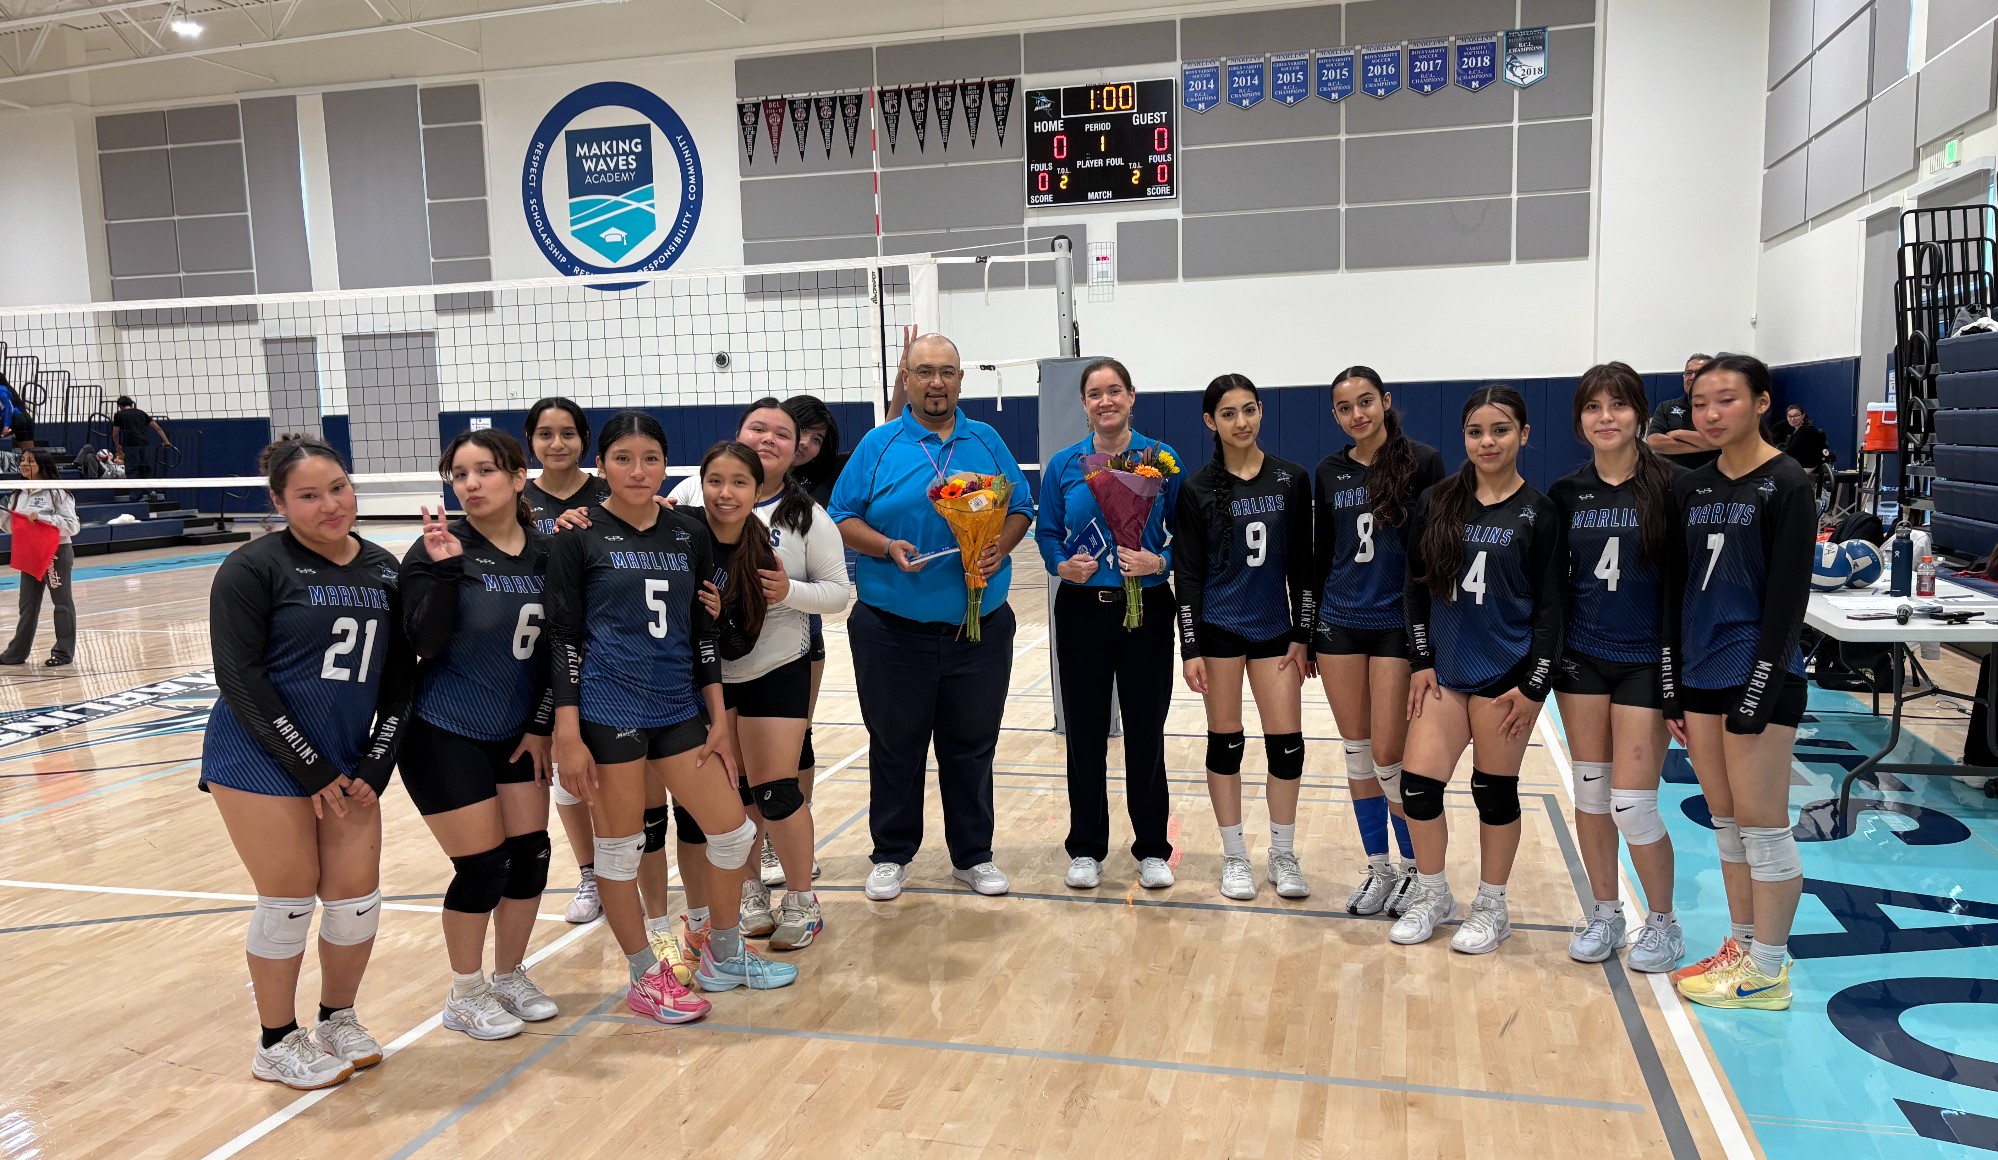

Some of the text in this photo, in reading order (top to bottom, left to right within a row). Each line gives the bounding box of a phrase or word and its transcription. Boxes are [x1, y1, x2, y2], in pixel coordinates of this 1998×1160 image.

[1367, 64, 1395, 77] 2016
[1414, 60, 1442, 73] 2017
[1461, 55, 1491, 69] 2018
[1521, 66, 1543, 77] 2018
[1232, 75, 1259, 88] 2014
[1276, 71, 1304, 84] 2015
[1321, 68, 1349, 80] 2015
[1188, 78, 1214, 91] 2014
[1090, 84, 1133, 111] 1:00
[1033, 120, 1065, 133] HOME
[1085, 122, 1111, 132] PERIOD
[1132, 111, 1168, 126] GUEST
[575, 138, 642, 158] MAKING
[1053, 135, 1067, 159] 0
[1100, 135, 1105, 152] 1
[1154, 127, 1168, 152] 0
[528, 141, 545, 188] RESPECT
[582, 154, 637, 173] WAVES
[675, 134, 697, 201] COMMUNITY
[1030, 162, 1053, 172] FOULS
[1076, 157, 1125, 169] PLAYER FOUL
[1148, 153, 1172, 163] FOULS
[584, 172, 636, 184] ACADEMY
[1038, 172, 1049, 192] 0
[1059, 175, 1069, 190] 2
[1131, 169, 1141, 185] 2
[1157, 164, 1168, 183] 0
[1030, 194, 1054, 204] SCORE
[1087, 191, 1112, 200] MATCH
[1146, 186, 1170, 196] SCORE
[529, 198, 567, 264] SCHOLARSHIP
[1228, 494, 1285, 517] ARLINS
[1245, 521, 1267, 567] 9
[1354, 512, 1375, 563] 8
[610, 551, 690, 572] MARLINS
[1593, 537, 1620, 591] 4
[1701, 532, 1725, 591] 7
[308, 585, 389, 611] MARLINS
[644, 578, 669, 639] 5
[1300, 590, 1313, 628] MARLINS
[512, 603, 545, 660] 6
[1180, 604, 1195, 645] MARLINS
[320, 617, 378, 683] 21
[564, 644, 580, 684] ARLINS
[1661, 647, 1675, 699] MARLINS
[1739, 660, 1774, 717] MARLINS
[272, 714, 319, 766] MARLINS
[367, 715, 400, 761] MARLINS
